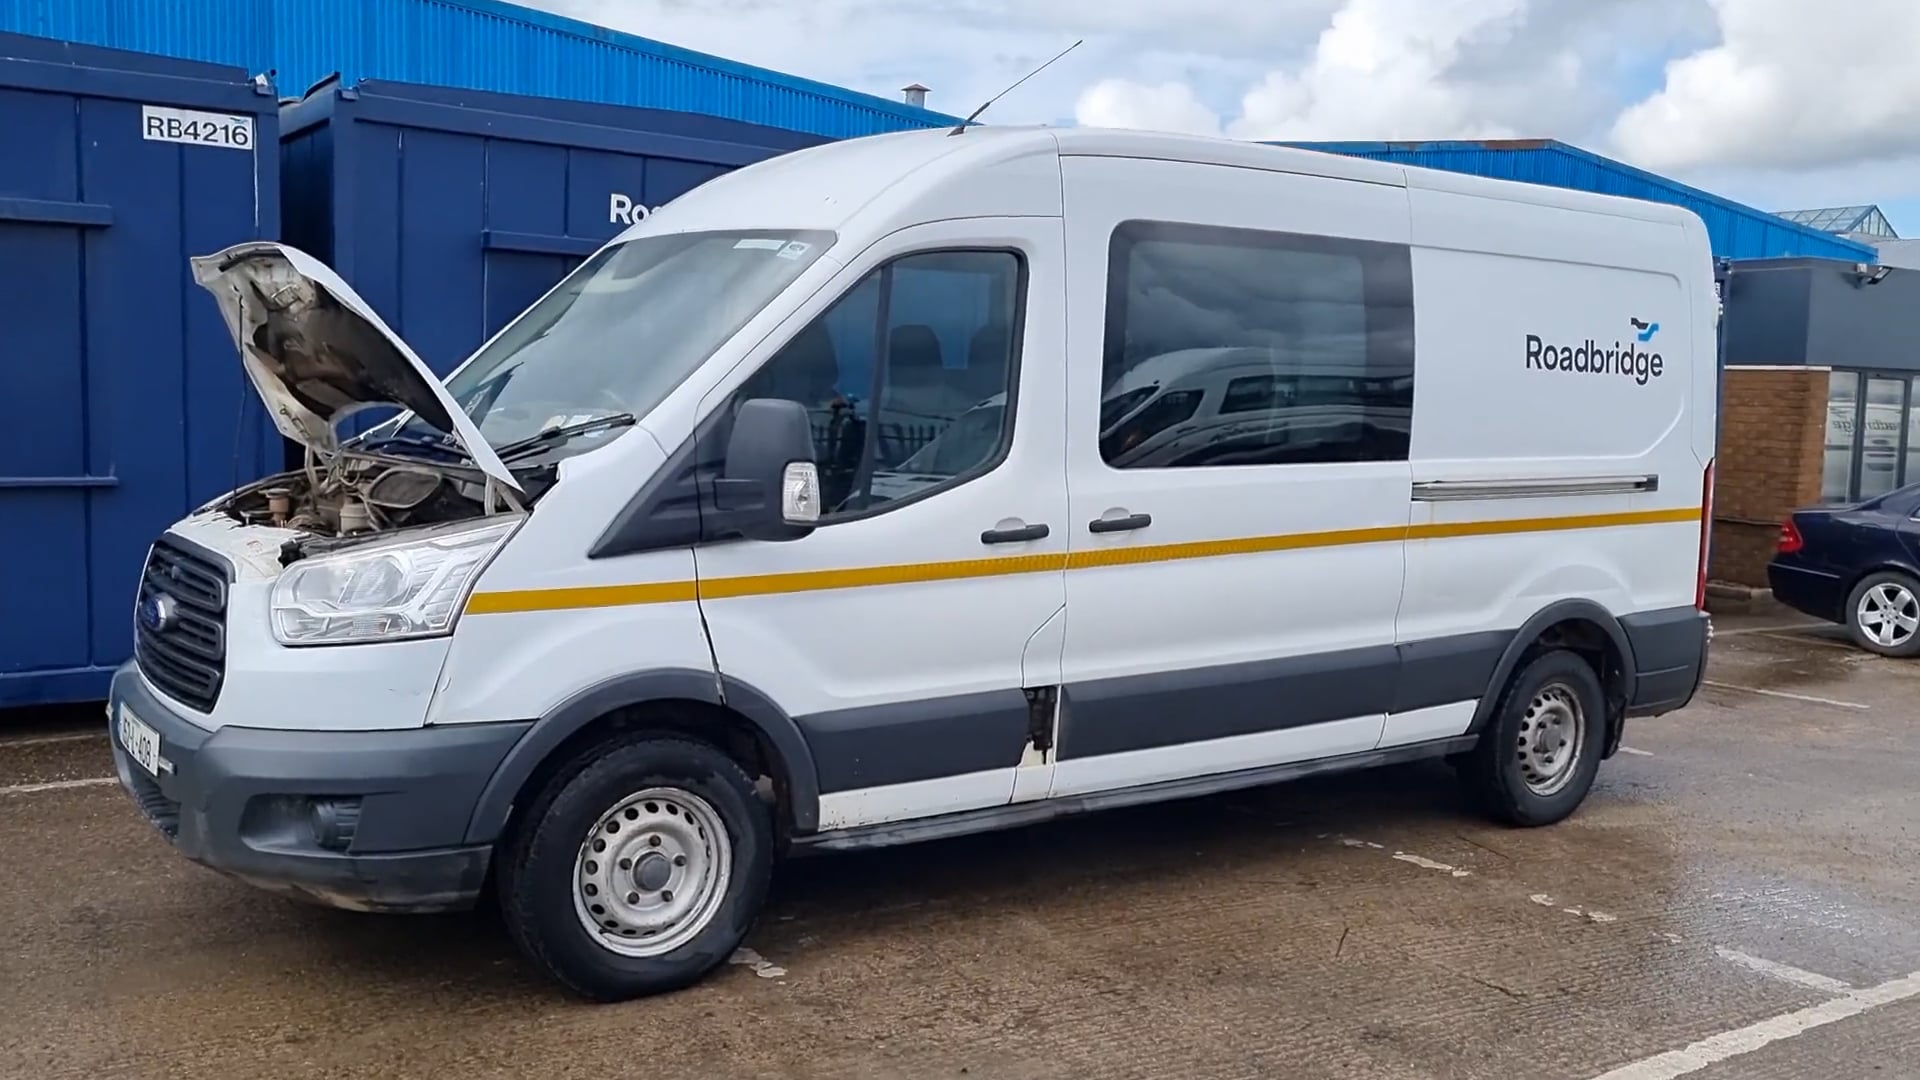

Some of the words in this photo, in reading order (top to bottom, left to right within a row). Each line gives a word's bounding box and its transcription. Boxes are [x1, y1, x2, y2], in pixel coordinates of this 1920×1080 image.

[146, 115, 249, 146] RB4216
[610, 193, 662, 225] Ro
[1526, 334, 1663, 386] Roadbridge
